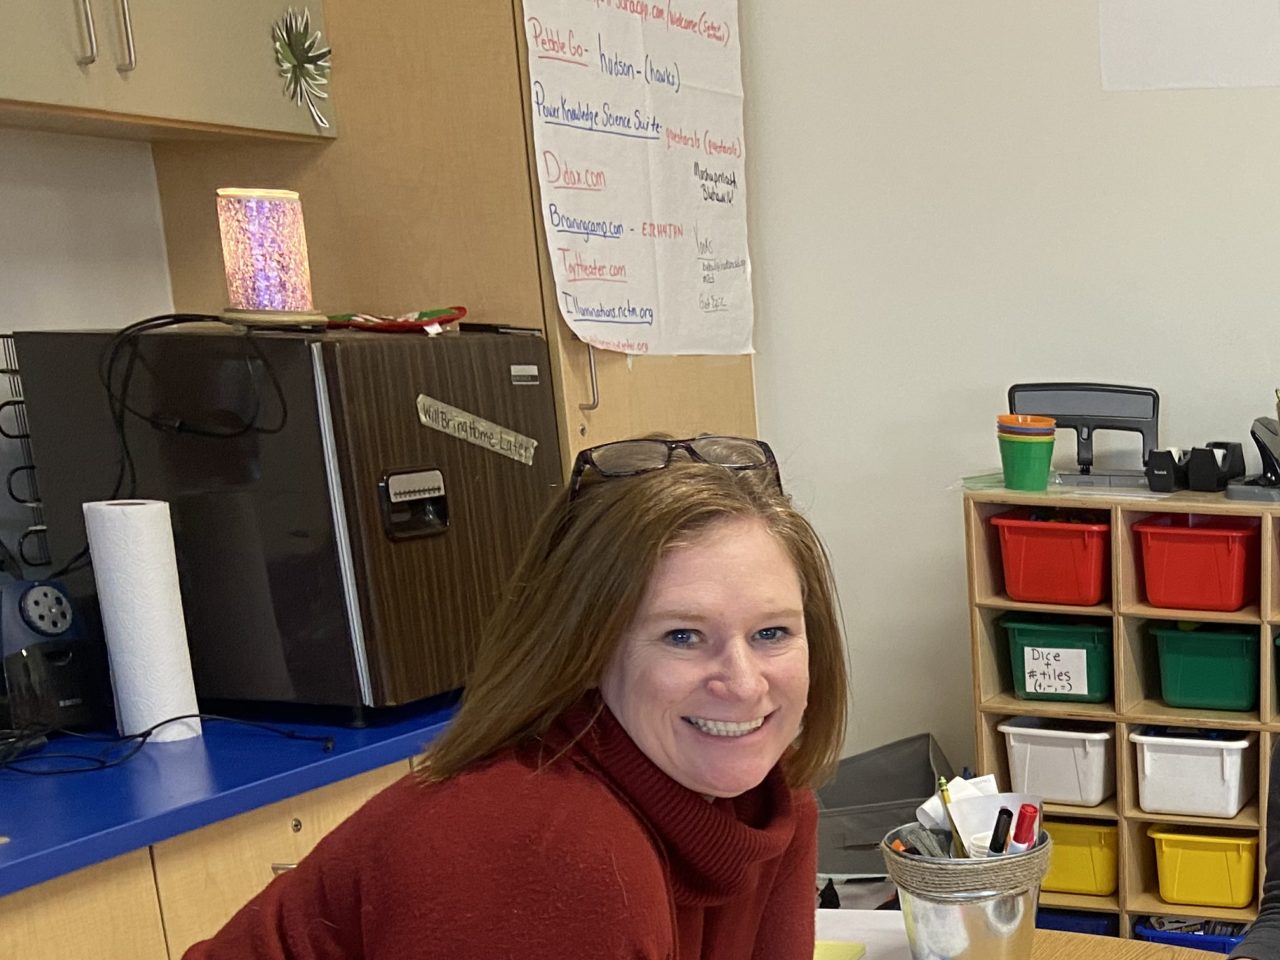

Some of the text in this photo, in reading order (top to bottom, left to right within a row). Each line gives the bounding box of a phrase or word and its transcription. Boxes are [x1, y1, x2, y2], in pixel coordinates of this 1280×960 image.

[602, 103, 632, 129] Science
[422, 403, 440, 427] Will
[440, 411, 468, 439] Bring
[469, 421, 495, 447] Home
[1032, 648, 1061, 661] Dice
[1040, 669, 1071, 682] tiles
